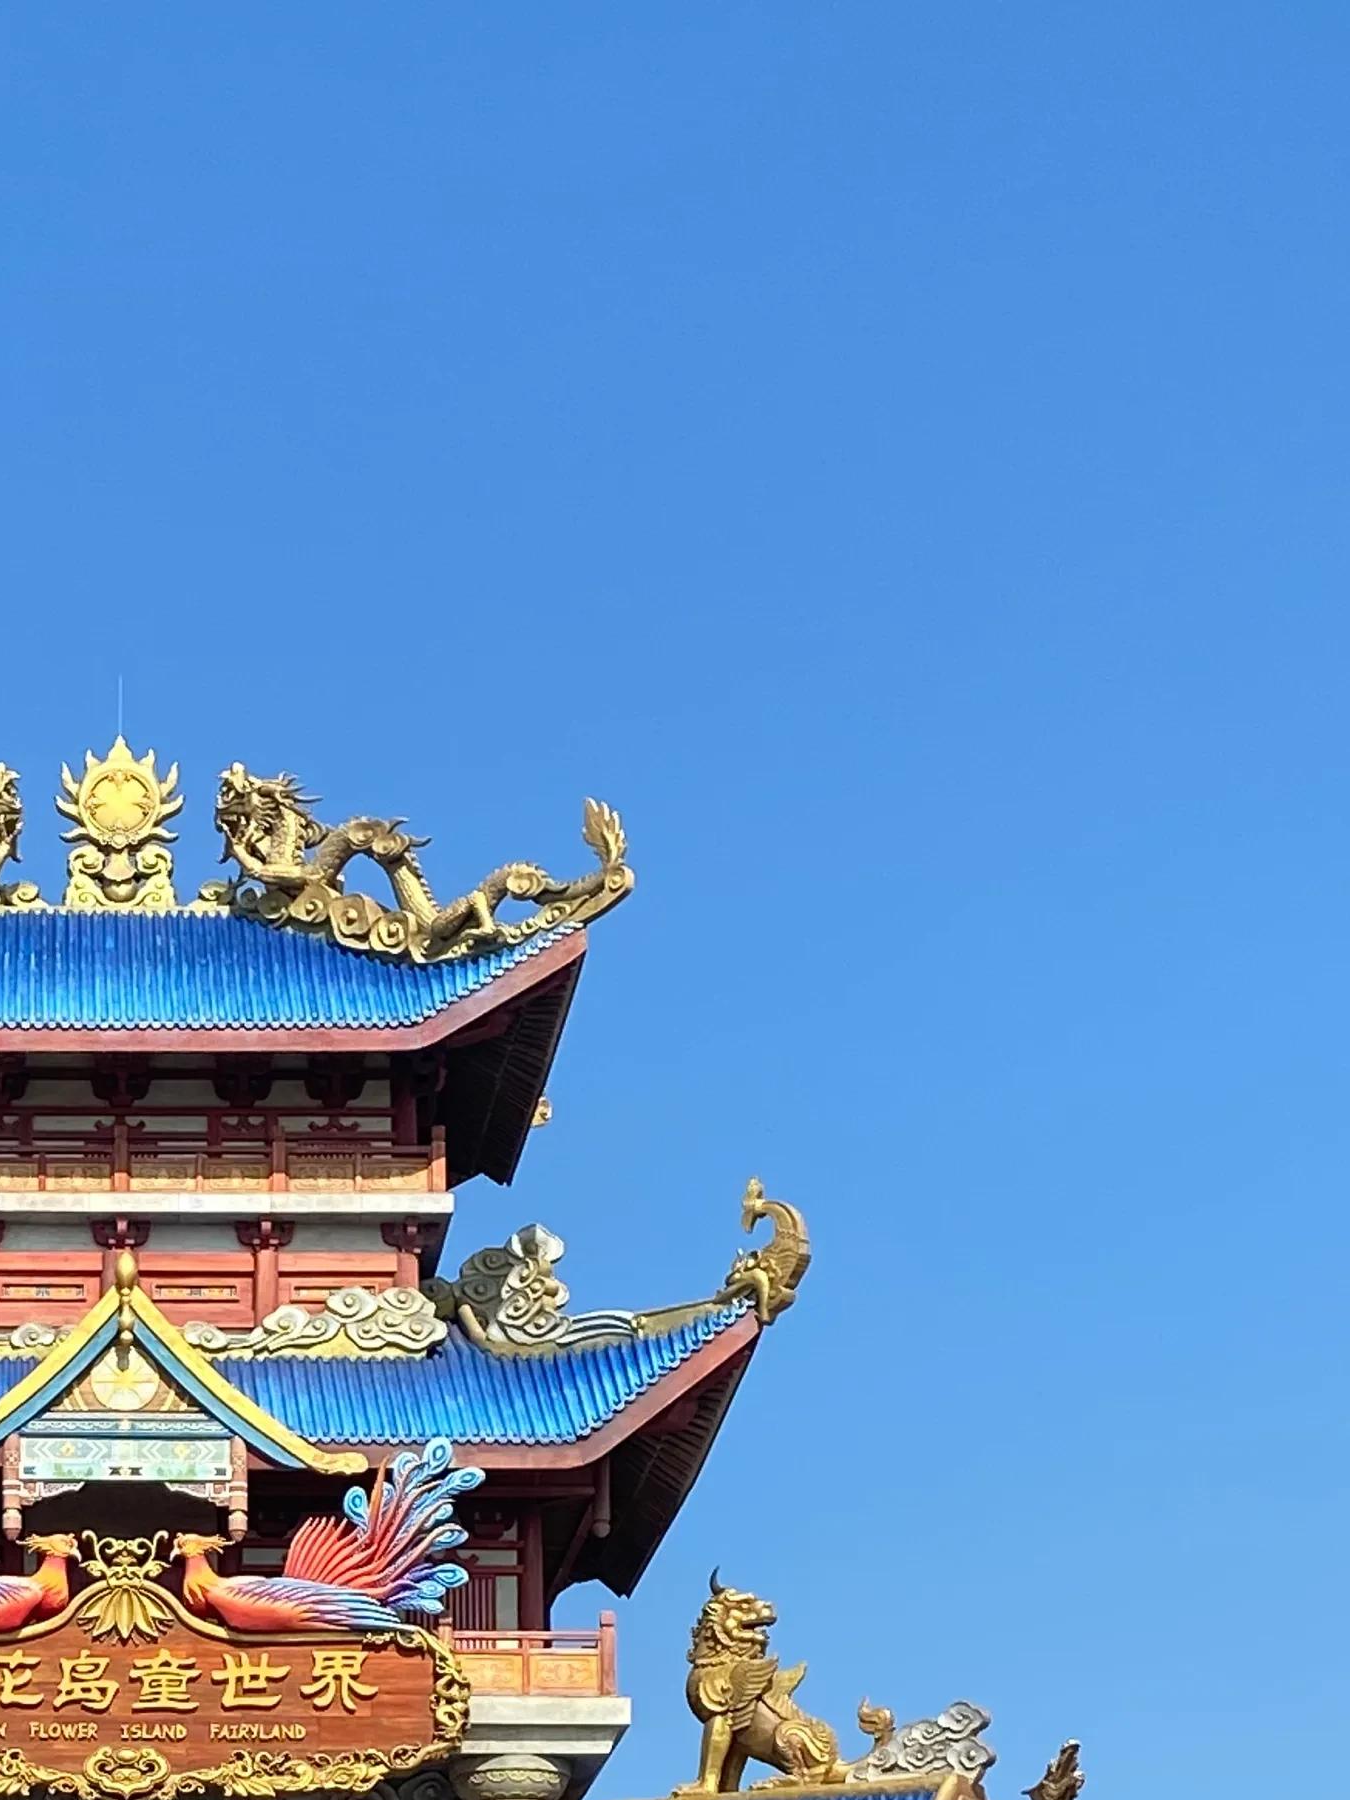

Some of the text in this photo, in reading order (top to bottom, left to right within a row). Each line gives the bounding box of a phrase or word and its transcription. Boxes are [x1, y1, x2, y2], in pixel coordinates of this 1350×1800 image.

[29, 1722, 98, 1741] FLOWER
[120, 1722, 187, 1741] ISLAND
[210, 1722, 307, 1742] FAIRYLAND
